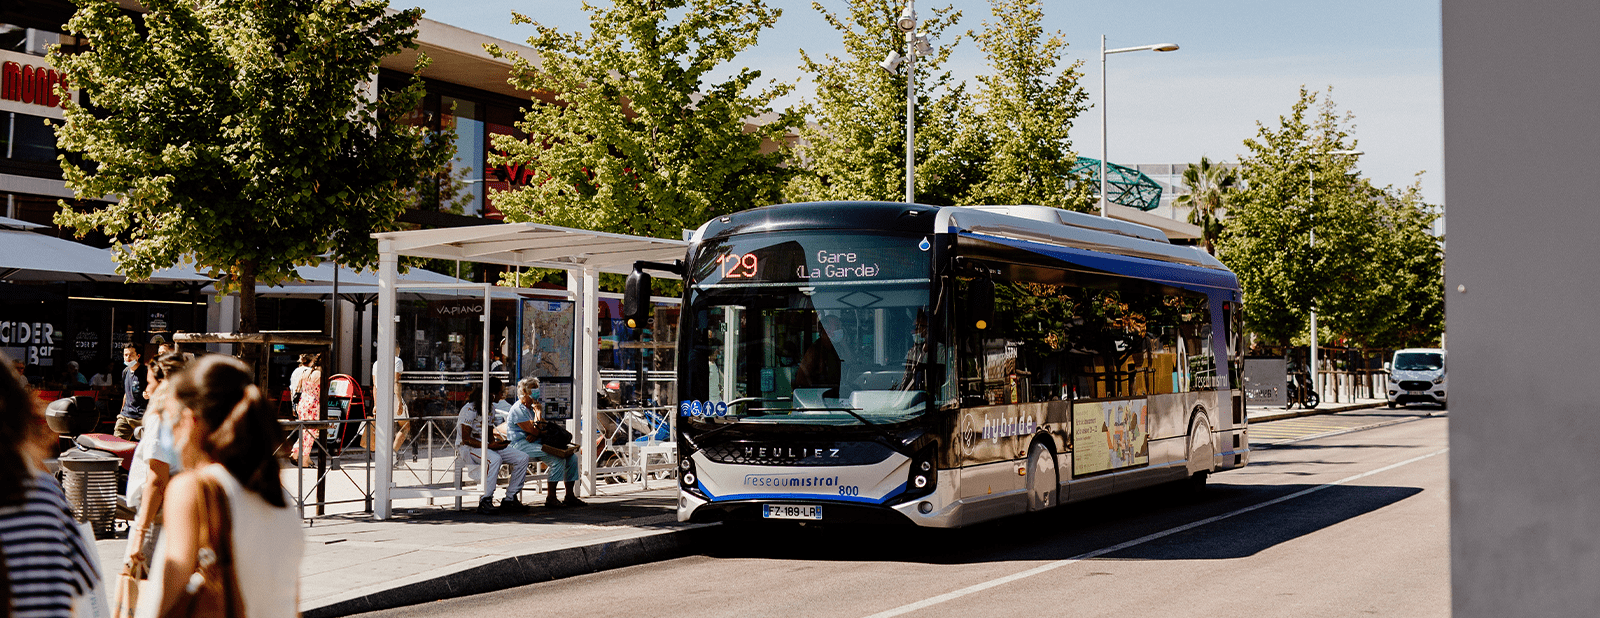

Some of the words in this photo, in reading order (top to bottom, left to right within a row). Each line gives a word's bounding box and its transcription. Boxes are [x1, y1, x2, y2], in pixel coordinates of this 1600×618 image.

[817, 250, 857, 264] Gare
[716, 252, 758, 279] 129
[436, 305, 483, 316] VAPIANO
[28, 345, 54, 365] Bar
[983, 410, 1033, 444] hybride
[744, 447, 840, 458] HEULIEZ
[838, 485, 859, 496] 800
[768, 506, 816, 517] FZ-189-LR
